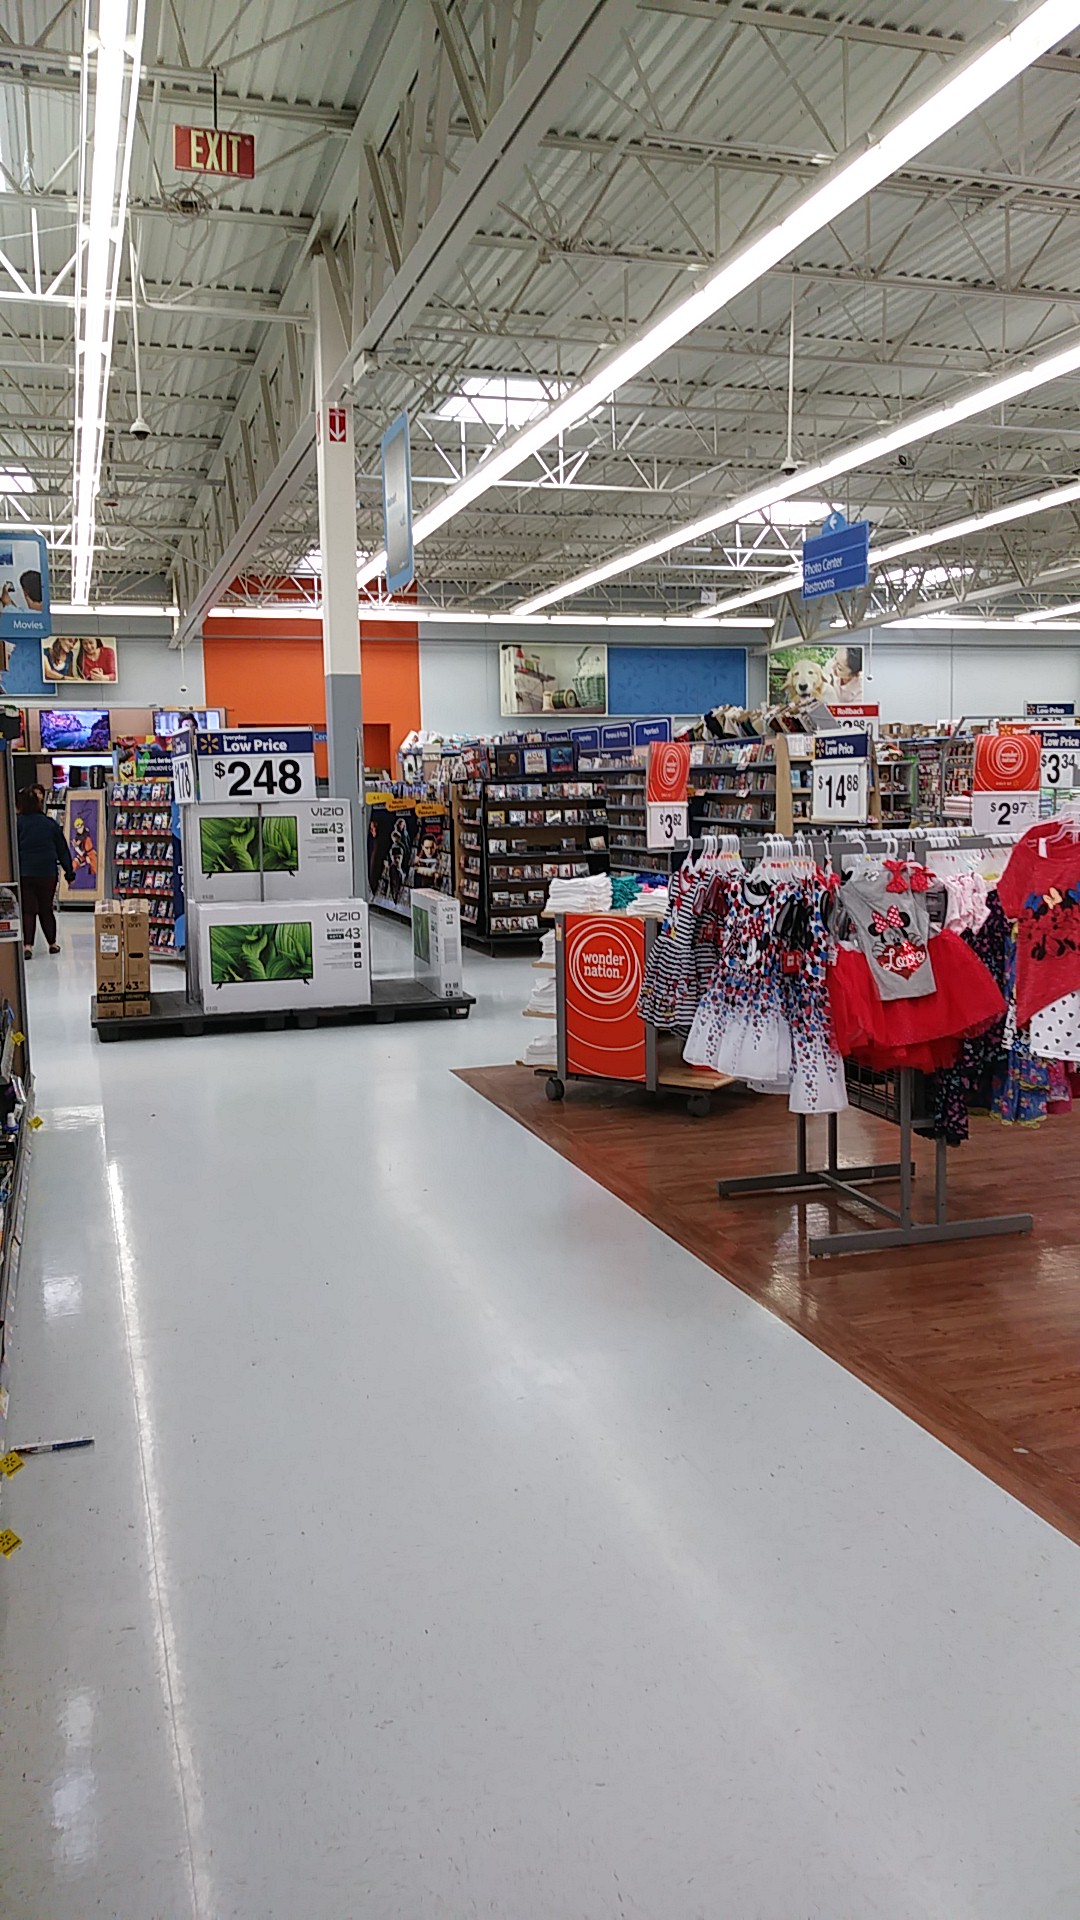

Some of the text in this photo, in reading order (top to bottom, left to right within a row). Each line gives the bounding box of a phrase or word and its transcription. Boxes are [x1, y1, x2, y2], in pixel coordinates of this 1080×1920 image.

[190, 129, 242, 173] EXIT
[804, 557, 842, 576] Photo Center
[804, 578, 835, 594] Restrooms
[13, 620, 44, 629] Movies
[836, 706, 864, 715] Rollback
[1036, 705, 1049, 714] Low
[222, 734, 247, 742] Everyday
[1042, 735, 1080, 747] Low Price
[222, 738, 288, 753] Low Price
[825, 742, 854, 756] Low Price
[310, 807, 344, 816] VIZIO
[326, 911, 361, 922] VIZIO
[582, 948, 625, 966] wonder
[882, 948, 926, 971] Love
[583, 964, 624, 979] nation
